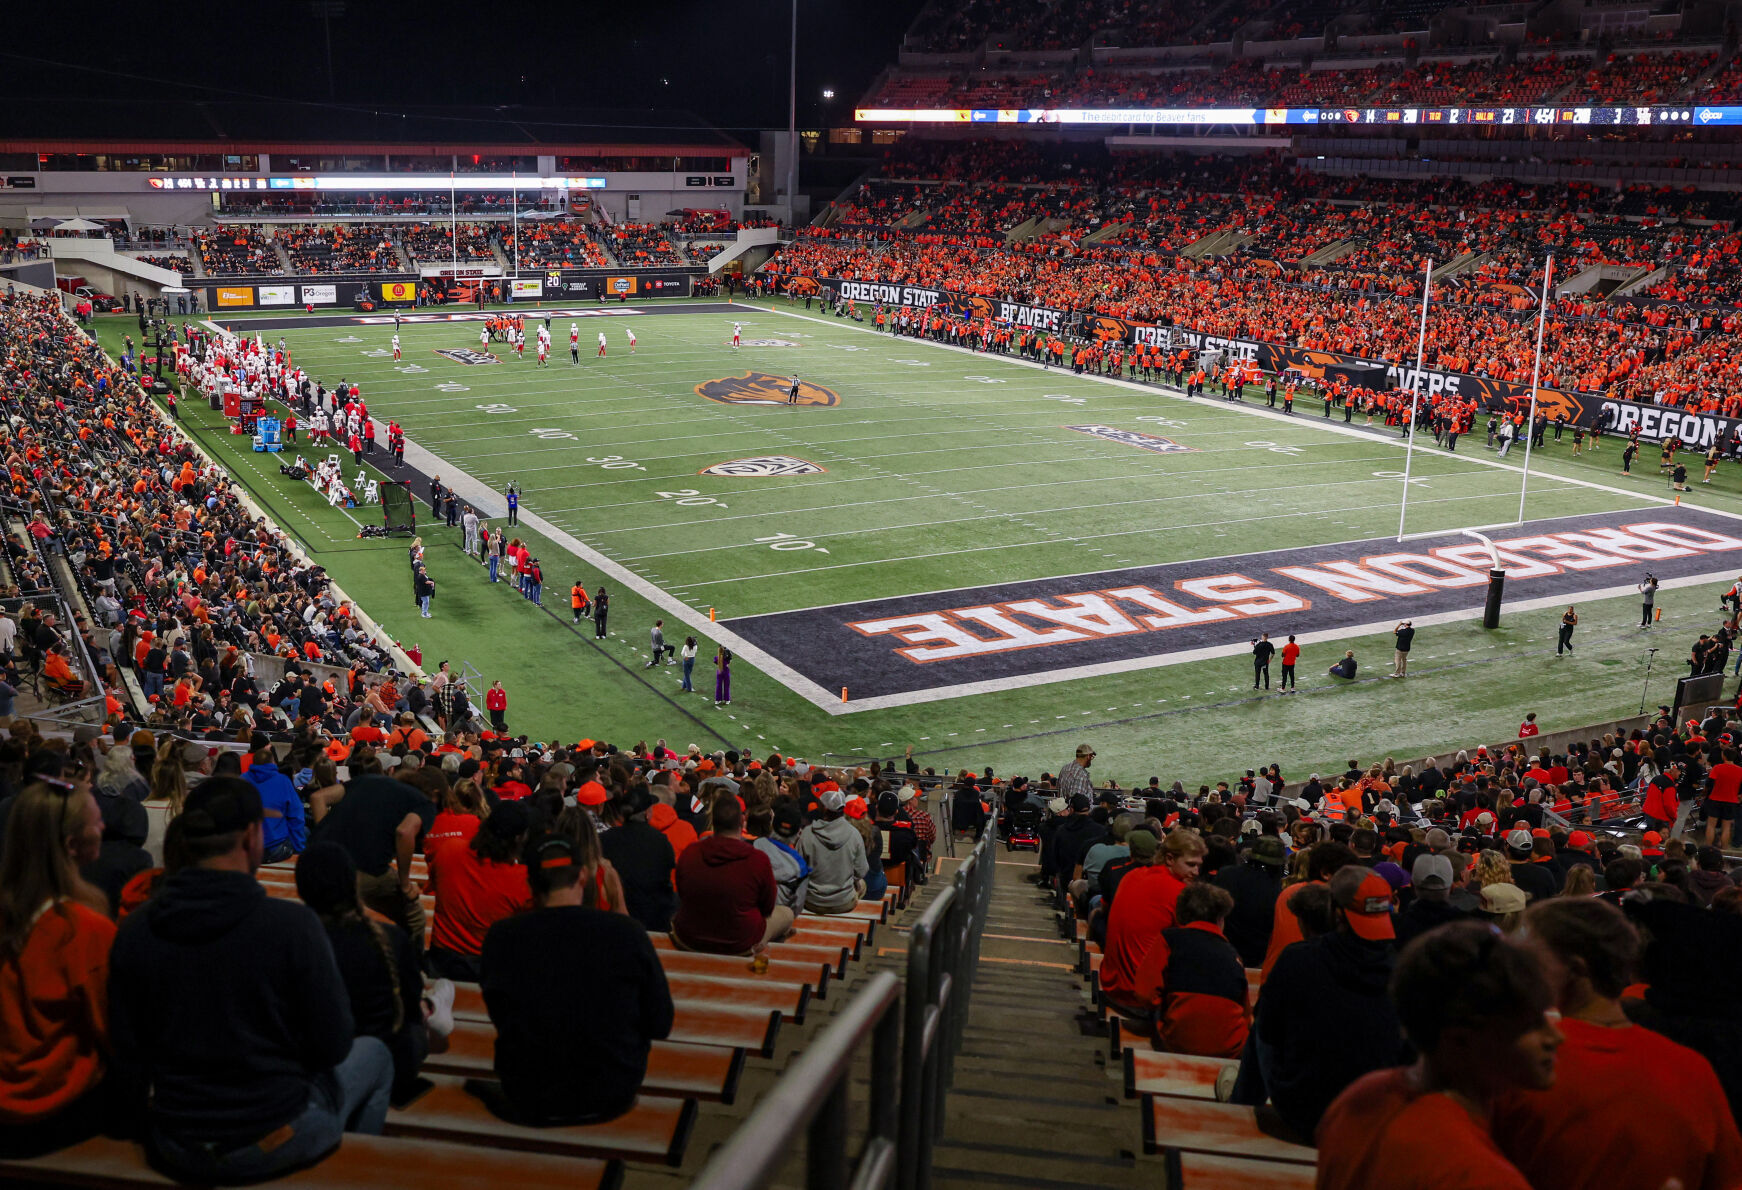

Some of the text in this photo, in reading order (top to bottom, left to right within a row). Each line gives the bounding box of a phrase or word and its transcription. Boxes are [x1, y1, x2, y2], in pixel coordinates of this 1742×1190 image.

[1081, 111, 1206, 122] The debit card for Beaver fans
[1502, 109, 1515, 123] 23
[547, 276, 559, 286] 20
[303, 288, 315, 297] P3
[841, 282, 940, 307] OREGON STATE
[1001, 303, 1061, 331] BEAVERS
[1205, 336, 1259, 360] STATE
[1601, 402, 1728, 447] OREGON
[586, 455, 639, 470] 30
[655, 489, 717, 506] 20
[753, 532, 816, 551] 10
[844, 522, 1742, 664] OREGON STATE
